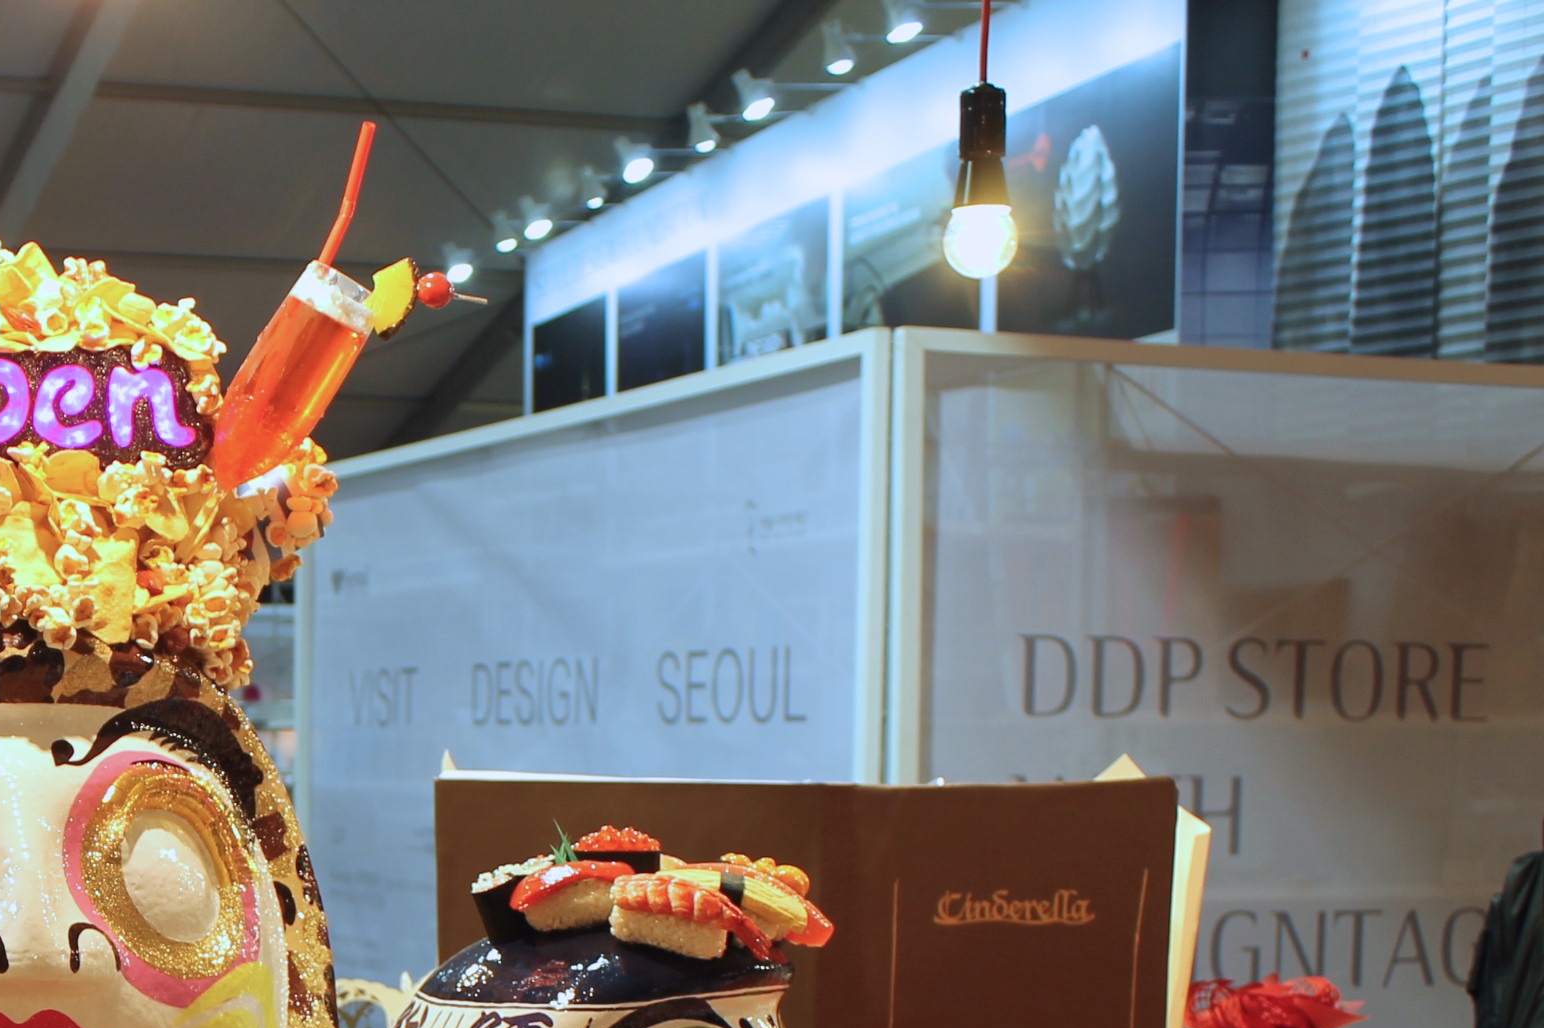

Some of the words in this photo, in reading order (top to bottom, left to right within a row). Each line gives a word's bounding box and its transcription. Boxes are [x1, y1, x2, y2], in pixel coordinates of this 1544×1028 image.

[348, 665, 418, 729] VISIT
[470, 656, 600, 728] DESIGN
[655, 645, 807, 726] SEOUL
[1017, 632, 1204, 718] DDP
[1226, 635, 1490, 724] STORE
[934, 886, 1096, 926] Cinderella
